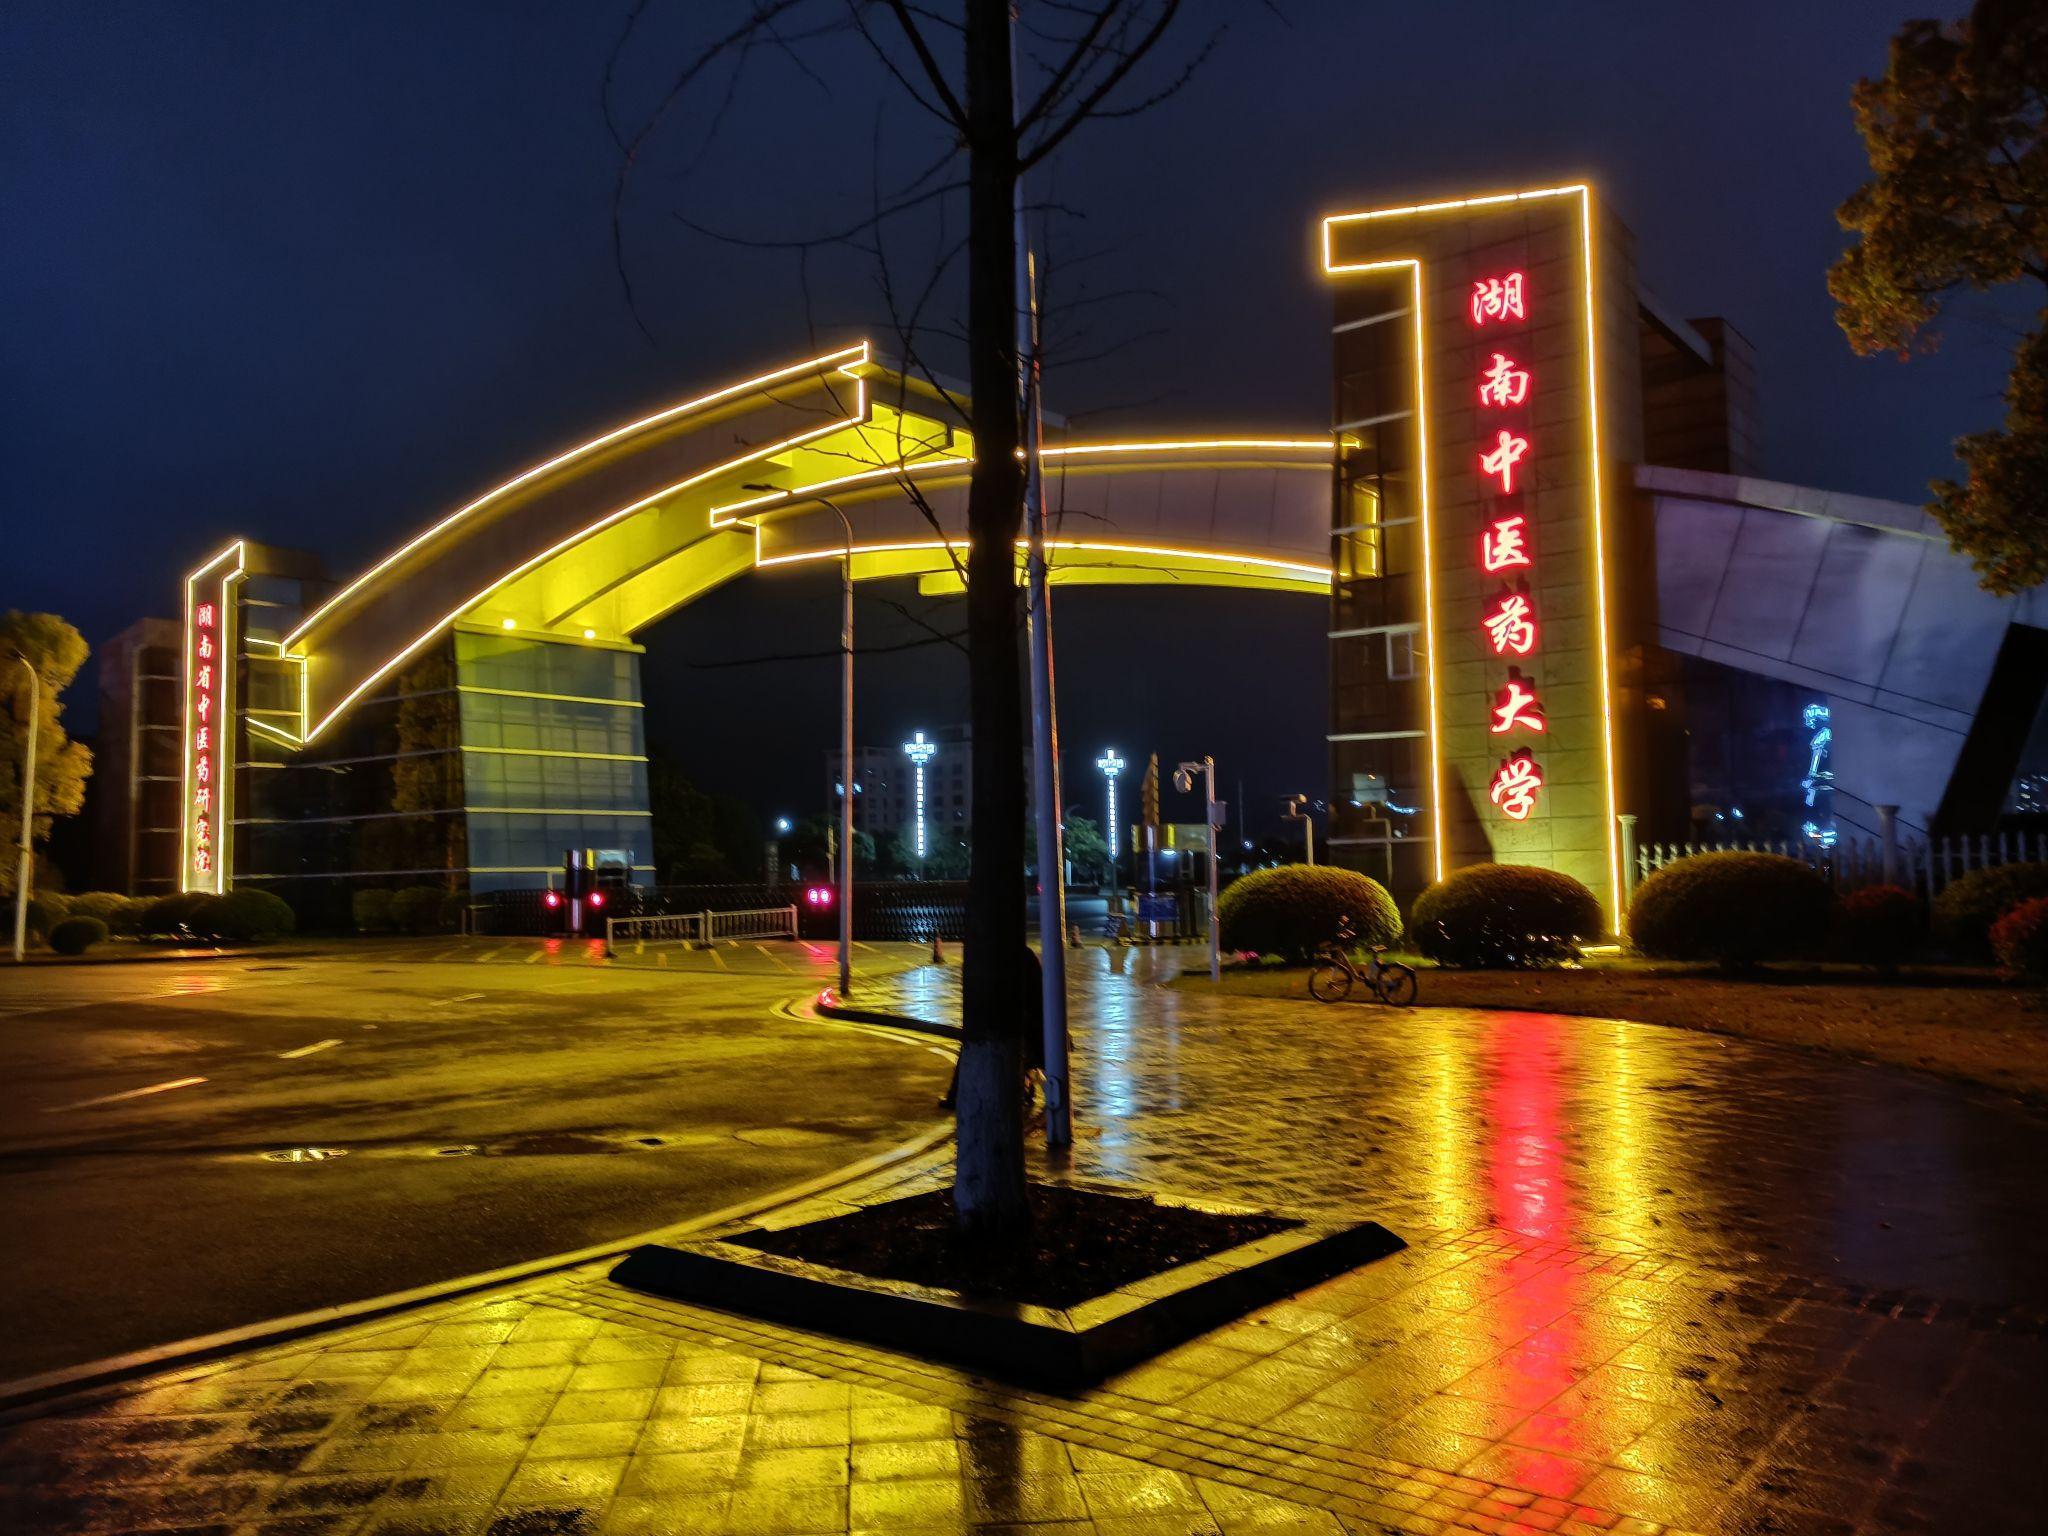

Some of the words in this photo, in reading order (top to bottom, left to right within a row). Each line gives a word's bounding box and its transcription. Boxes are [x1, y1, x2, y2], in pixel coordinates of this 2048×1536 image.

[1472, 271, 1545, 821] 湖南中医药大学
